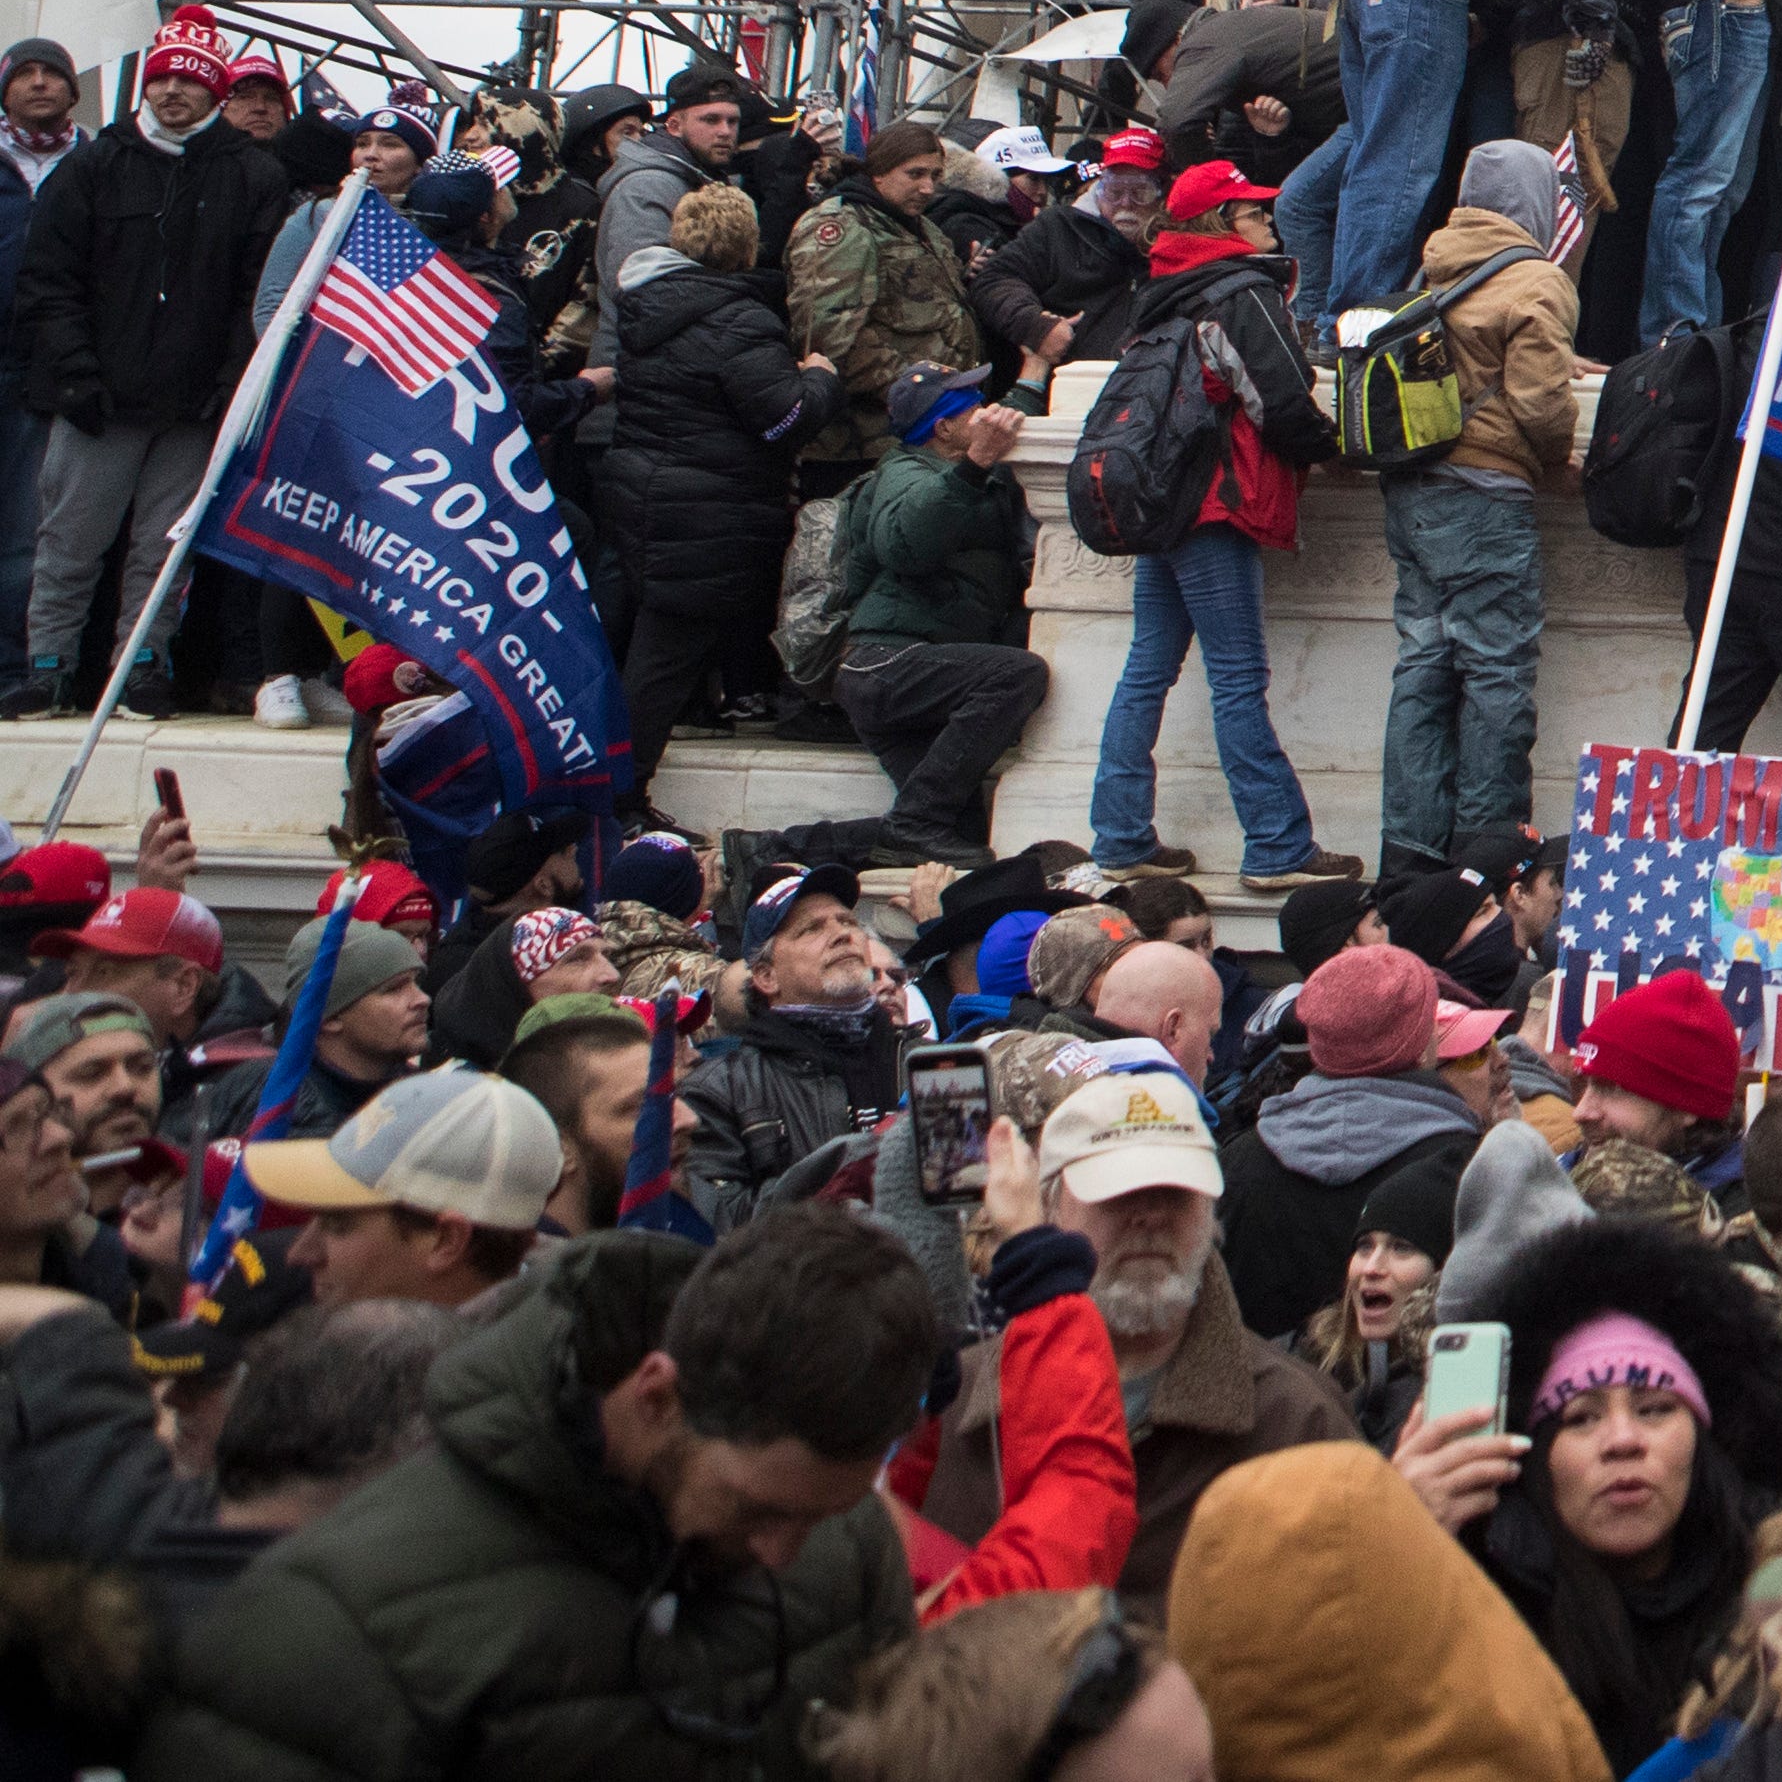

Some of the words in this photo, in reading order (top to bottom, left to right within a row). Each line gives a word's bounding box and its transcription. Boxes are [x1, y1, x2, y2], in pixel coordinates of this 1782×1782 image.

[168, 54, 220, 85] 2020
[995, 147, 1013, 163] 45
[1353, 389, 1363, 450] Coleman
[261, 475, 340, 534] KEEP
[339, 513, 495, 636] AMERICA
[1561, 948, 1765, 1056] UA
[1541, 1364, 1676, 1420] TRUMP
